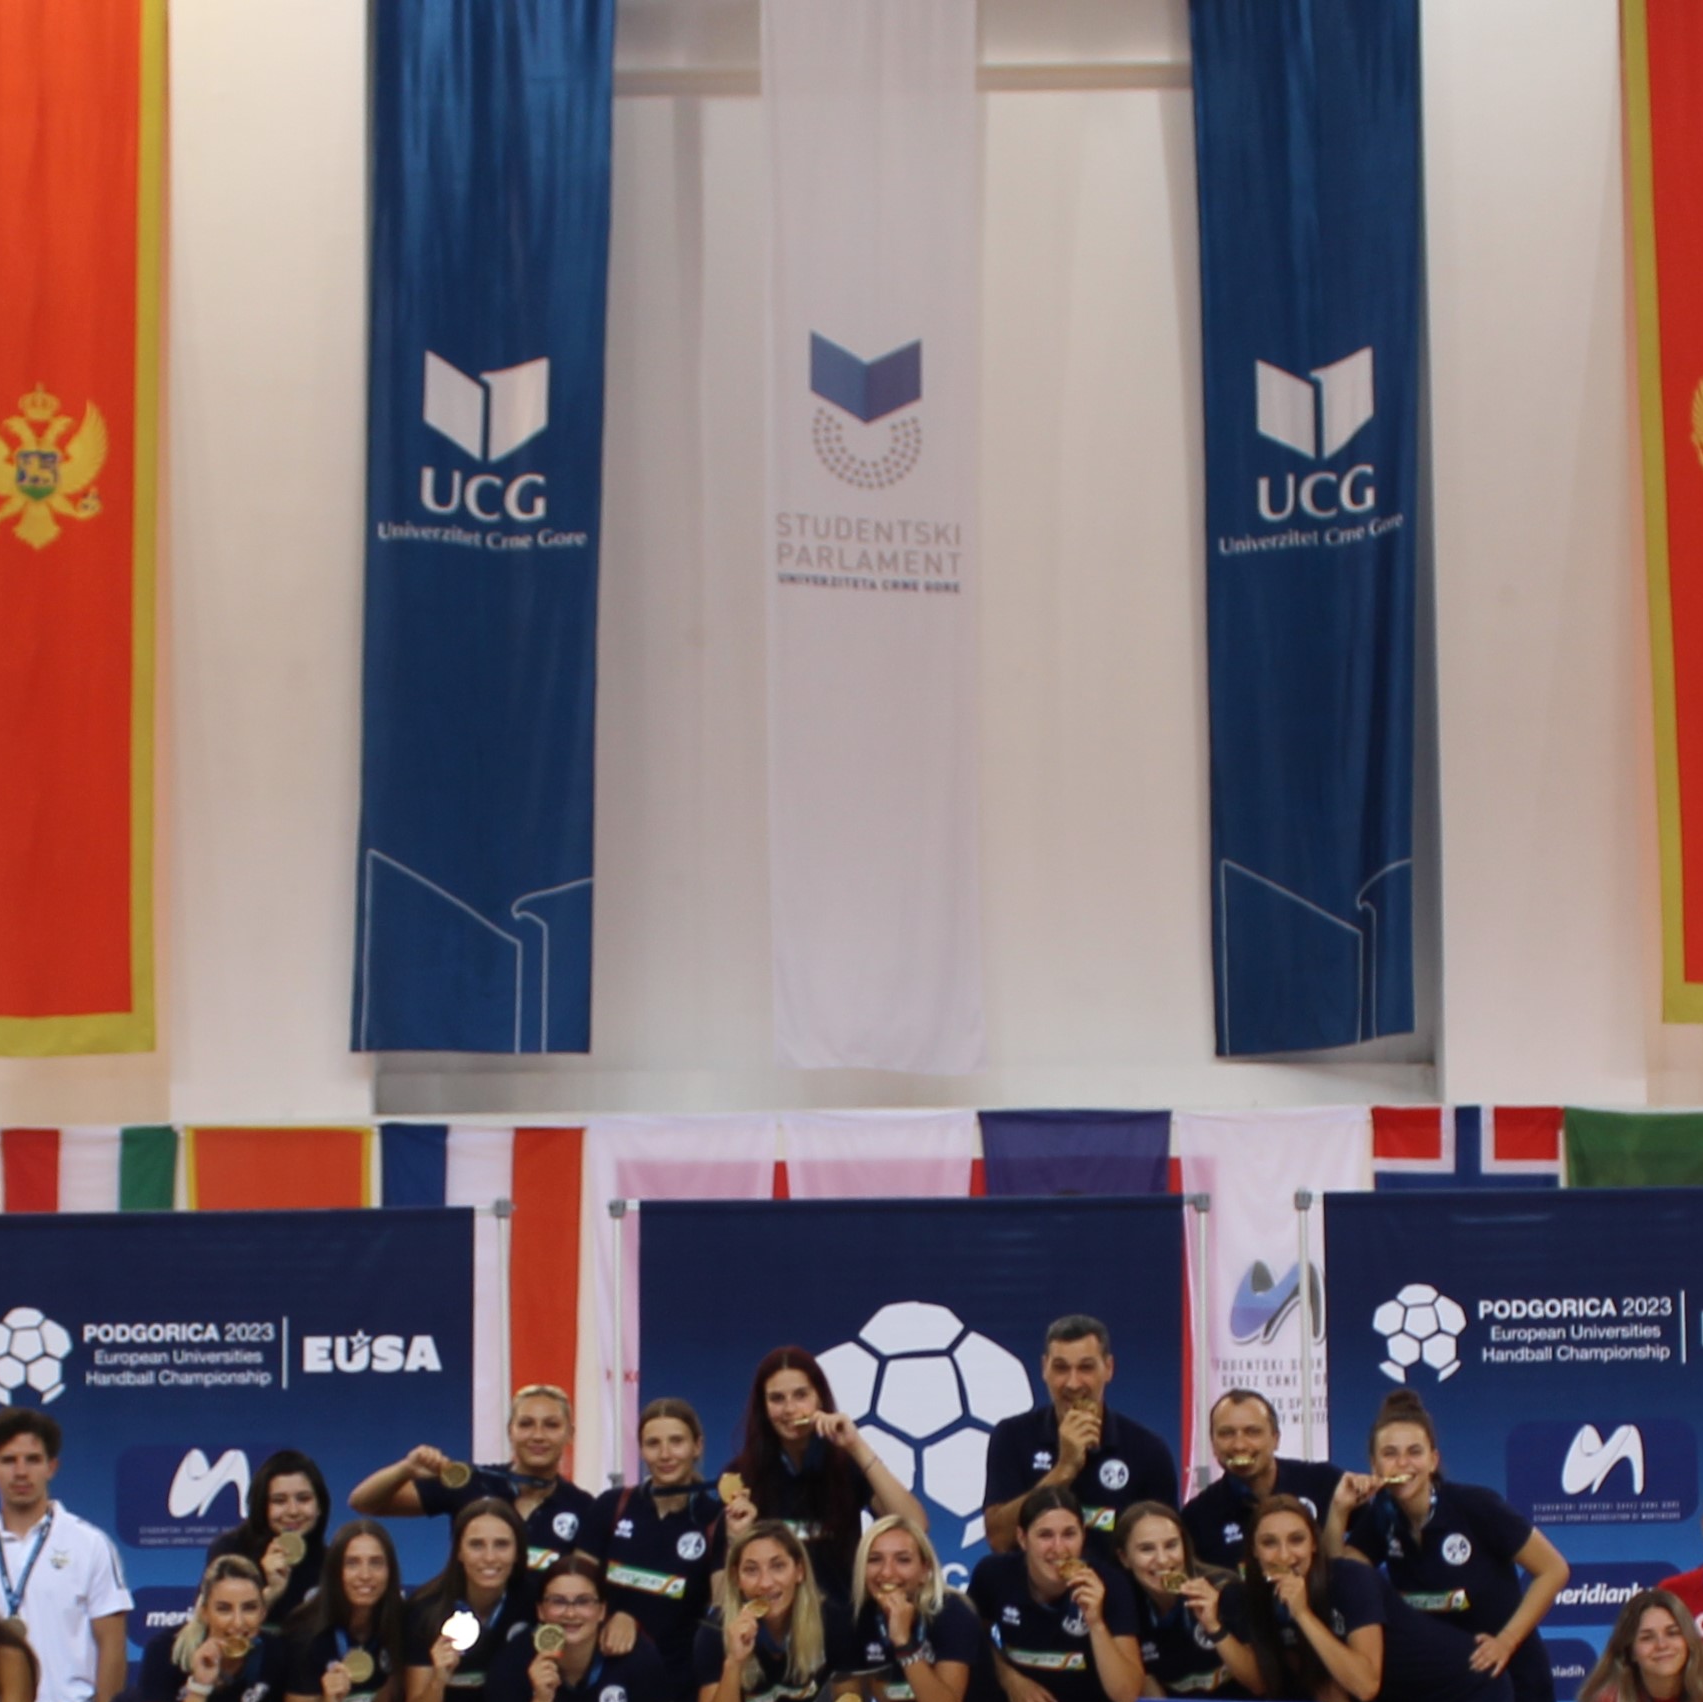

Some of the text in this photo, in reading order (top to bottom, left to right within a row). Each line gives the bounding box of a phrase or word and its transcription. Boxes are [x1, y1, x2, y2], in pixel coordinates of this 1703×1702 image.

[420, 466, 547, 523] UCG
[1257, 463, 1376, 522] UCG
[377, 521, 588, 550] Univerzitet Crne Gore
[775, 512, 962, 546] STUDENTSKI
[1218, 529, 1319, 556] Univerzitet
[776, 541, 963, 575] PARLAMENT
[1478, 1297, 1673, 1321] PODGORICA 2023
[82, 1323, 276, 1344] PODGORICA 2023
[1490, 1323, 1662, 1343] European Universities
[93, 1348, 263, 1367] European Universities
[302, 1329, 443, 1373] EUSA
[1481, 1343, 1671, 1363] Handball Championship
[85, 1368, 272, 1387] Handball Championship
